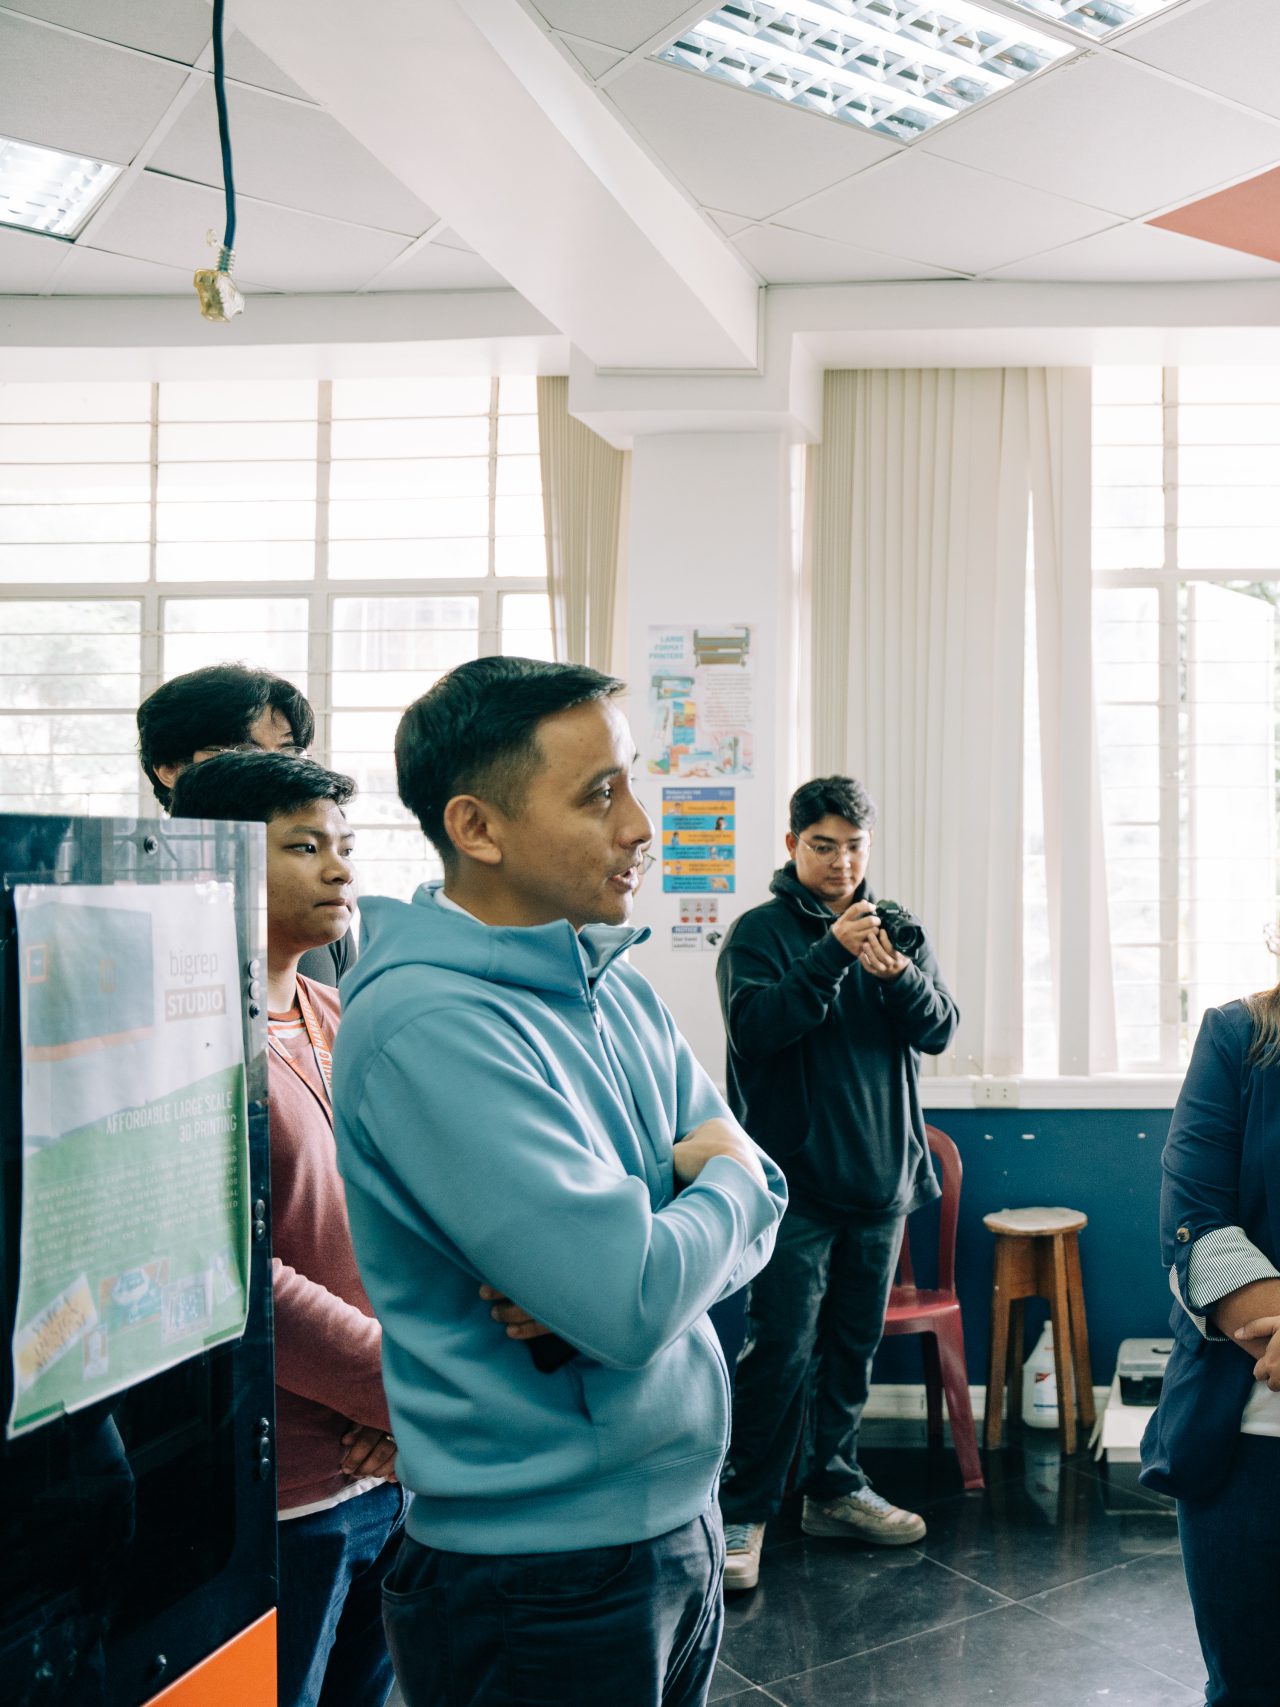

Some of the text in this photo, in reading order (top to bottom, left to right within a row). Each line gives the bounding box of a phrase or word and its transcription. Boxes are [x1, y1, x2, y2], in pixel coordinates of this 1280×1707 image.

[169, 950, 218, 984] bigrep
[167, 990, 224, 1017] STUDIO
[105, 1091, 233, 1135] AFFORDABLE LARGE SCALE
[179, 1114, 237, 1143] 3D PRINTING
